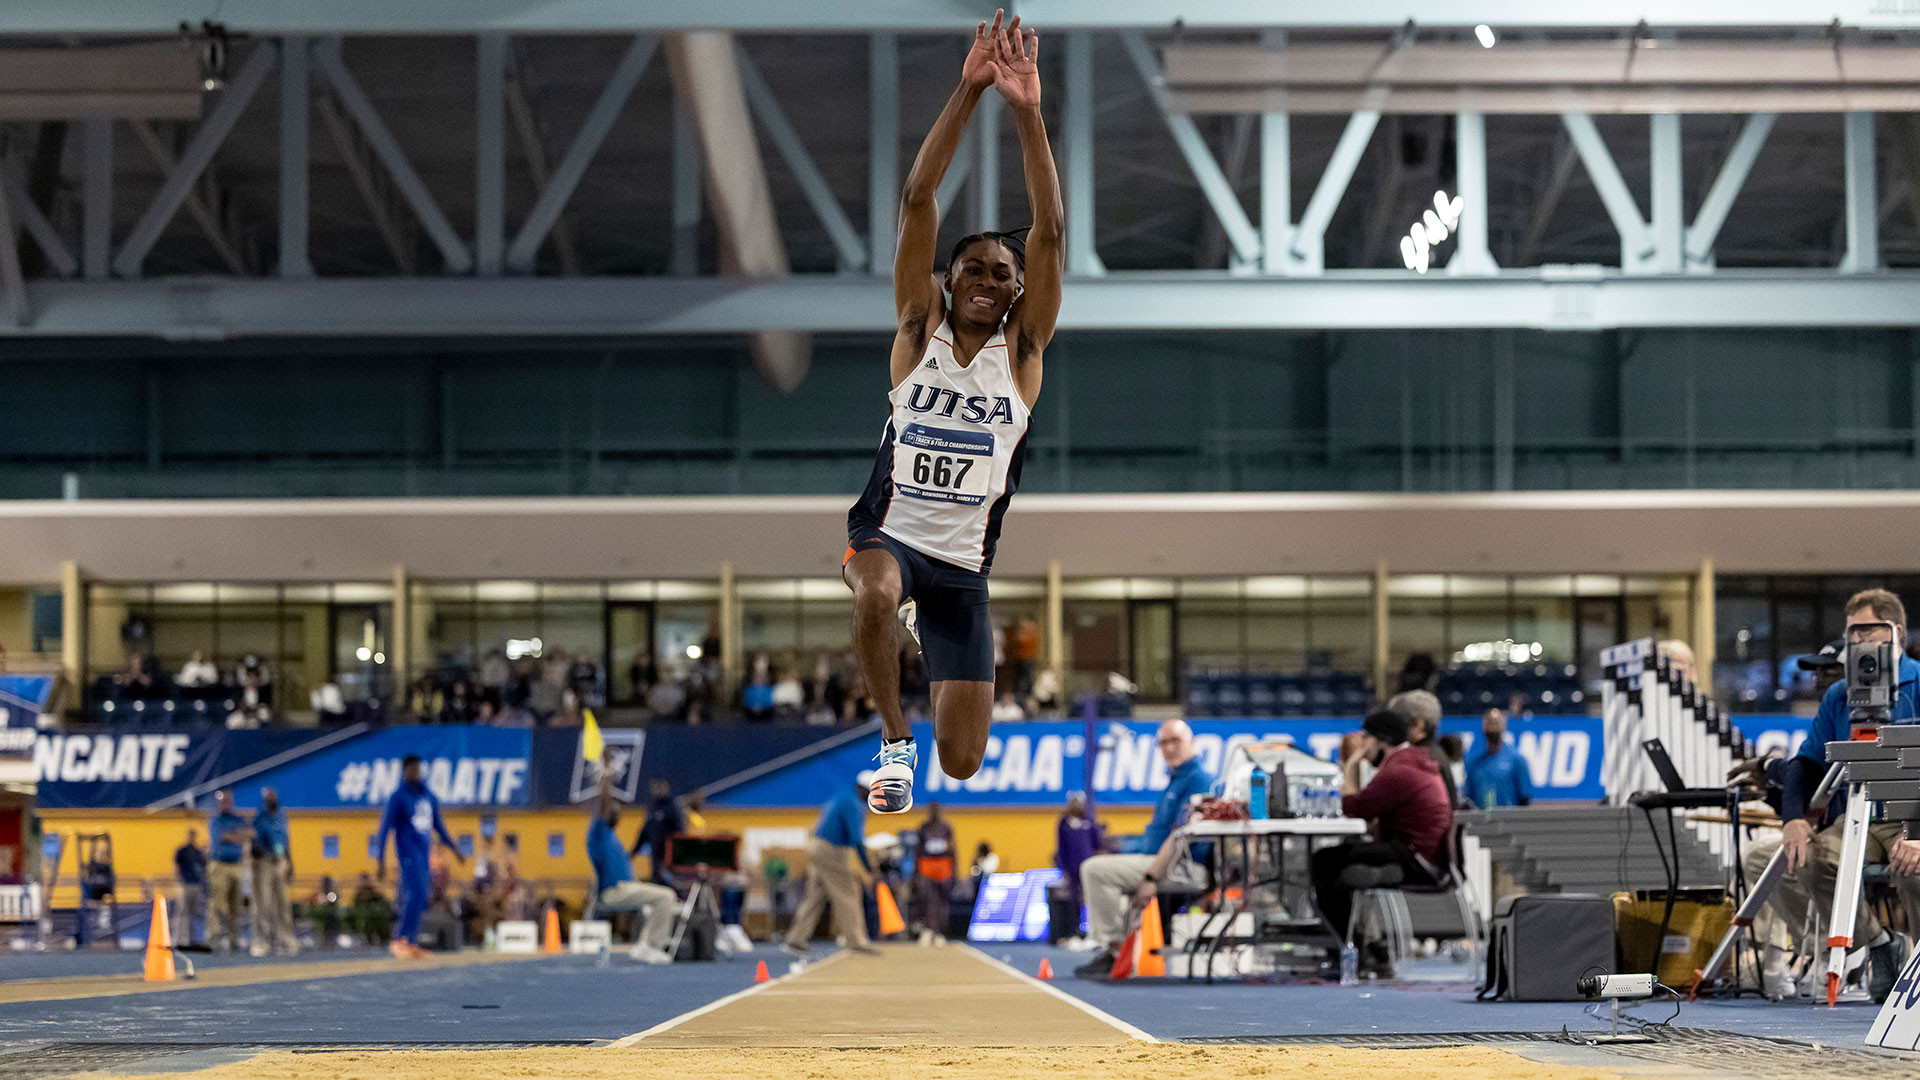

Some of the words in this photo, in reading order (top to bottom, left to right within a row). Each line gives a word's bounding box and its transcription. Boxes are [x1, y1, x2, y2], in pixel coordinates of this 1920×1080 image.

[908, 384, 1013, 424] UTSA
[913, 452, 974, 489] 667
[336, 758, 528, 804] #NAATF
